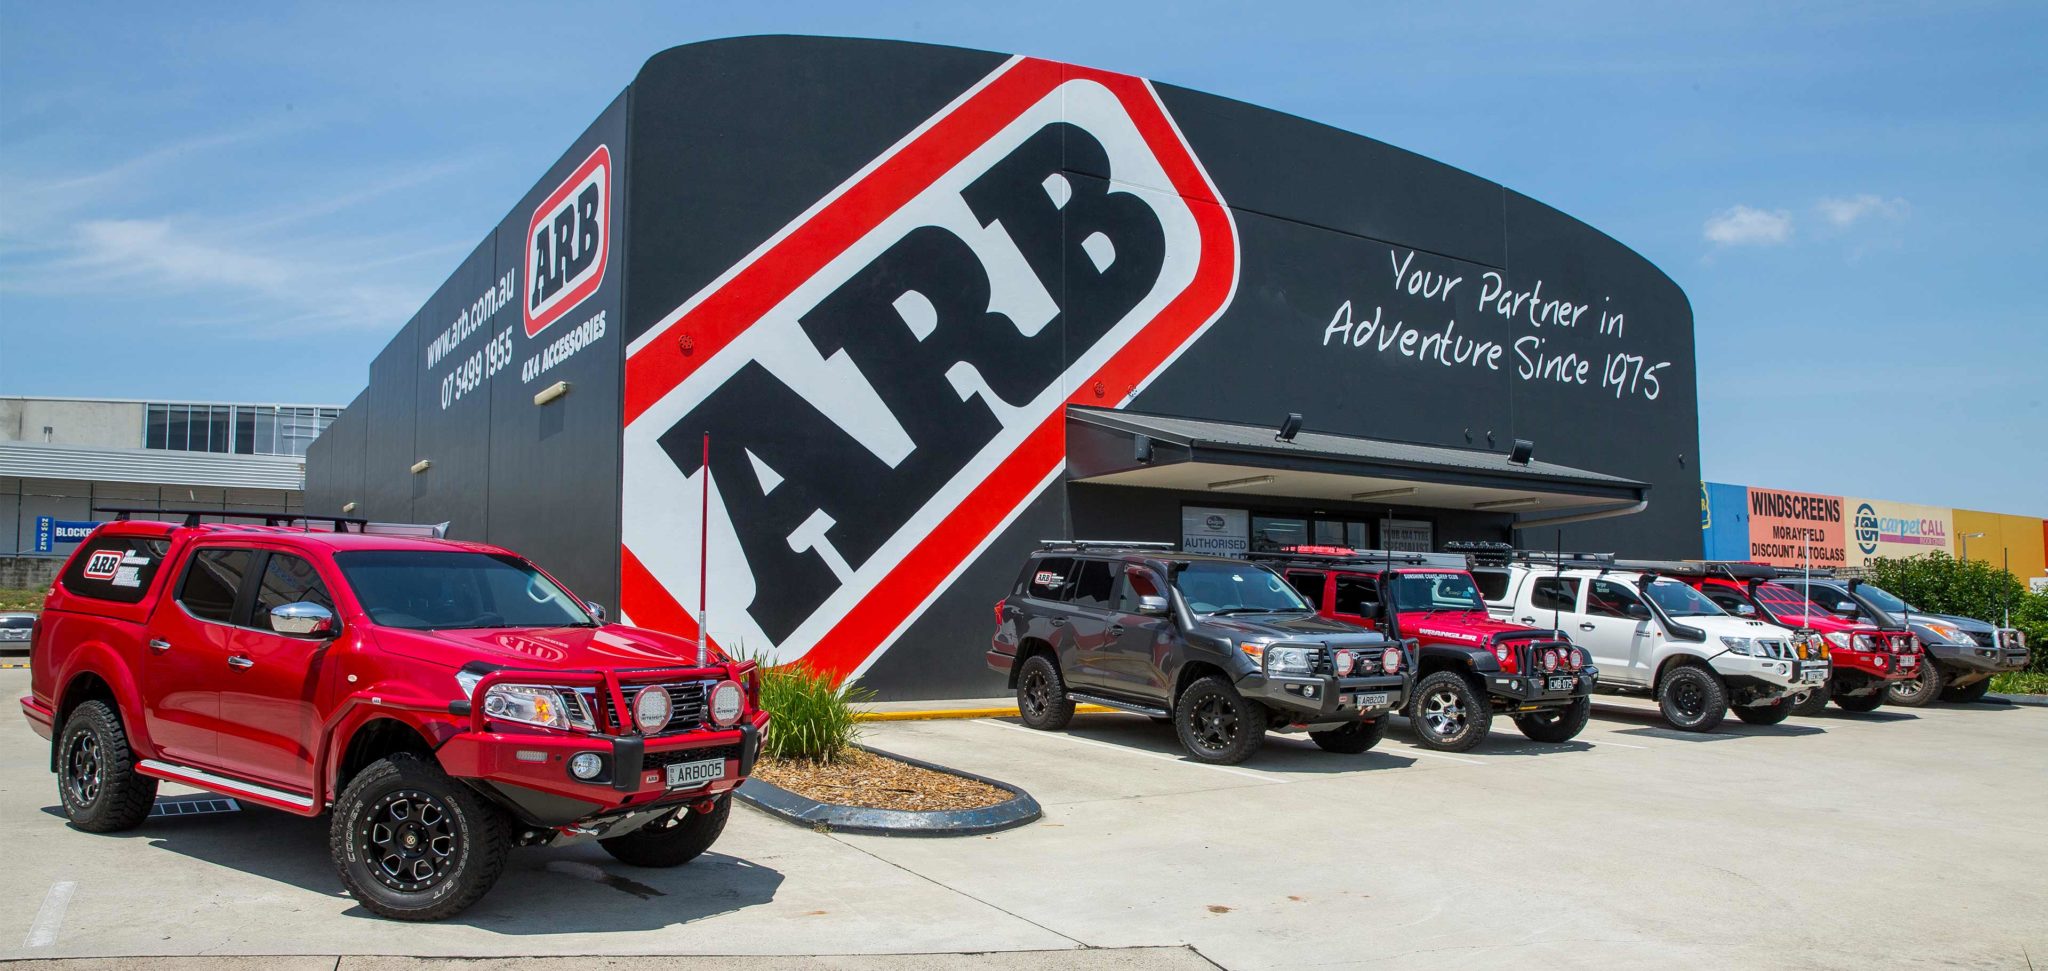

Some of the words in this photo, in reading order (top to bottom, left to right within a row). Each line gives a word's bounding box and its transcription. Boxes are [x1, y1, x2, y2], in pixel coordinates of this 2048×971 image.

[531, 181, 600, 312] ARB
[426, 267, 515, 370] www.arb.com.au
[1390, 250, 1463, 301] Your
[1479, 271, 1588, 328] Partner
[1599, 296, 1624, 338] in
[441, 375, 454, 410] 07
[455, 350, 482, 400] 5499
[485, 325, 513, 379] 1955
[541, 310, 607, 373] ACCESSORIES
[1323, 300, 1503, 370] Adventure
[1514, 335, 1589, 385] Since
[1602, 353, 1671, 400] 1975
[656, 121, 1167, 649] ARB
[1751, 491, 1841, 523] WINDSCREENS
[88, 555, 118, 573] ARB
[1184, 537, 1247, 550] AUTHORISED
[1751, 542, 1795, 558] DISCOUNT
[1419, 628, 1478, 642] WRANGLER
[1361, 695, 1385, 705] ARB200
[677, 762, 722, 782] ARB005
[346, 800, 364, 862] COOPER
